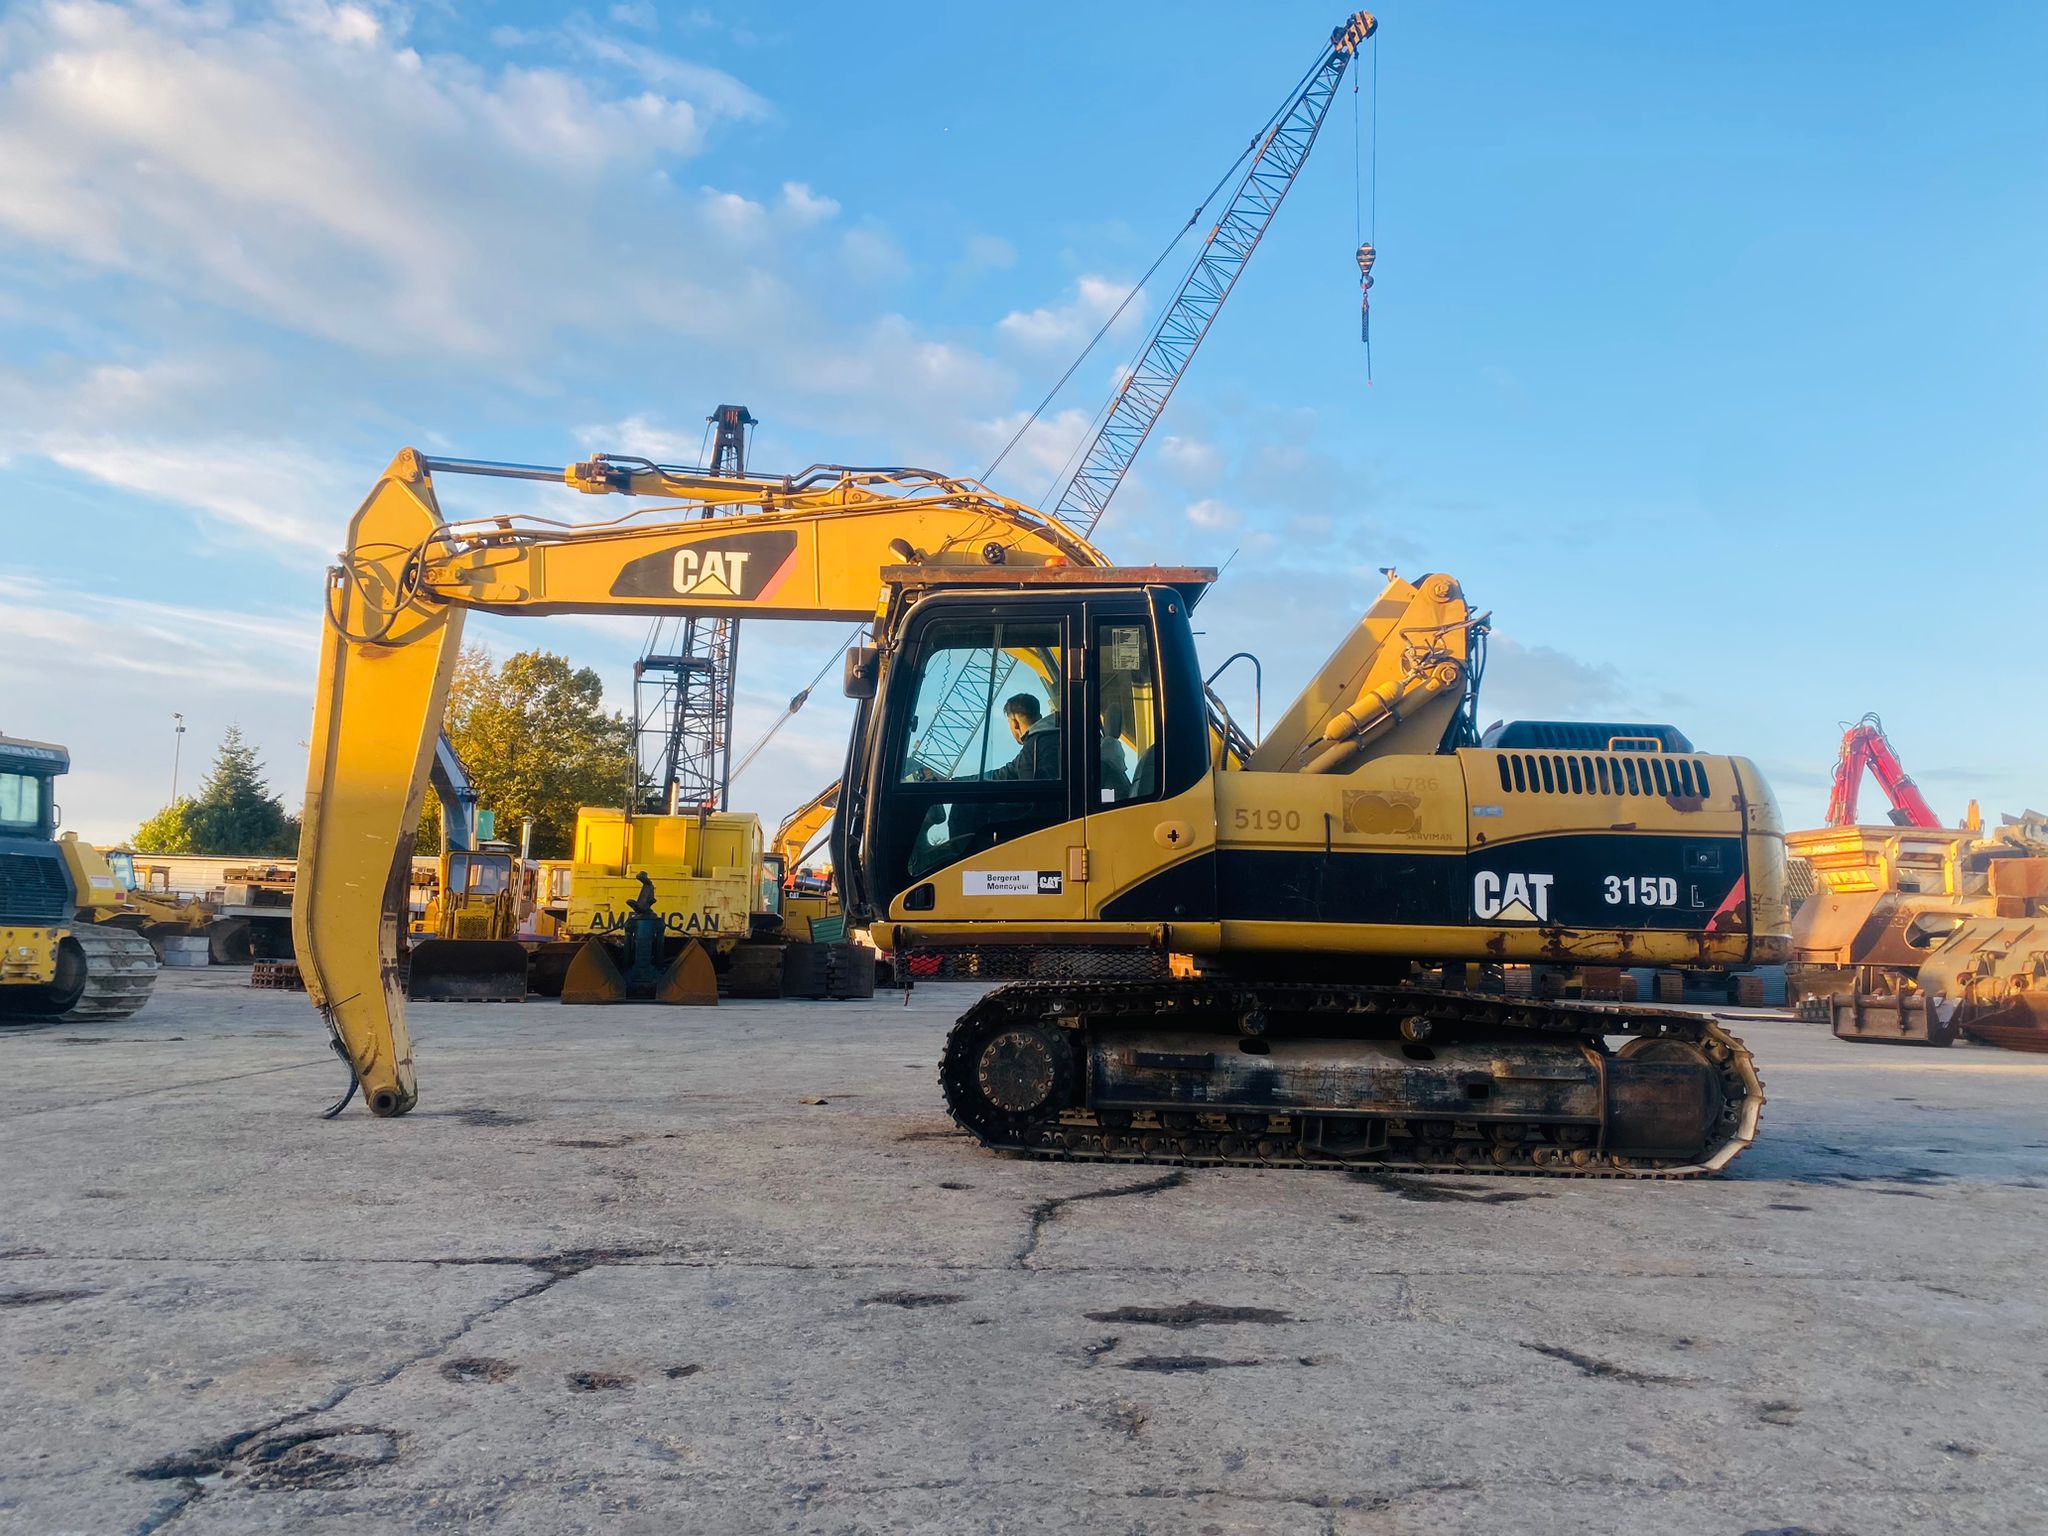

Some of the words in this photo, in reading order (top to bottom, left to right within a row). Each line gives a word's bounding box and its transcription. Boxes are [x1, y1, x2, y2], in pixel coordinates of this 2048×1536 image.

[673, 549, 749, 596] CAT
[0, 744, 55, 759] OMATSU
[1234, 808, 1300, 831] 5190
[986, 874, 1020, 882] Bergerat
[1039, 876, 1062, 889] CAT
[1474, 871, 1553, 922] CAT
[1604, 875, 1678, 906] 315D
[1691, 884, 1704, 907] L
